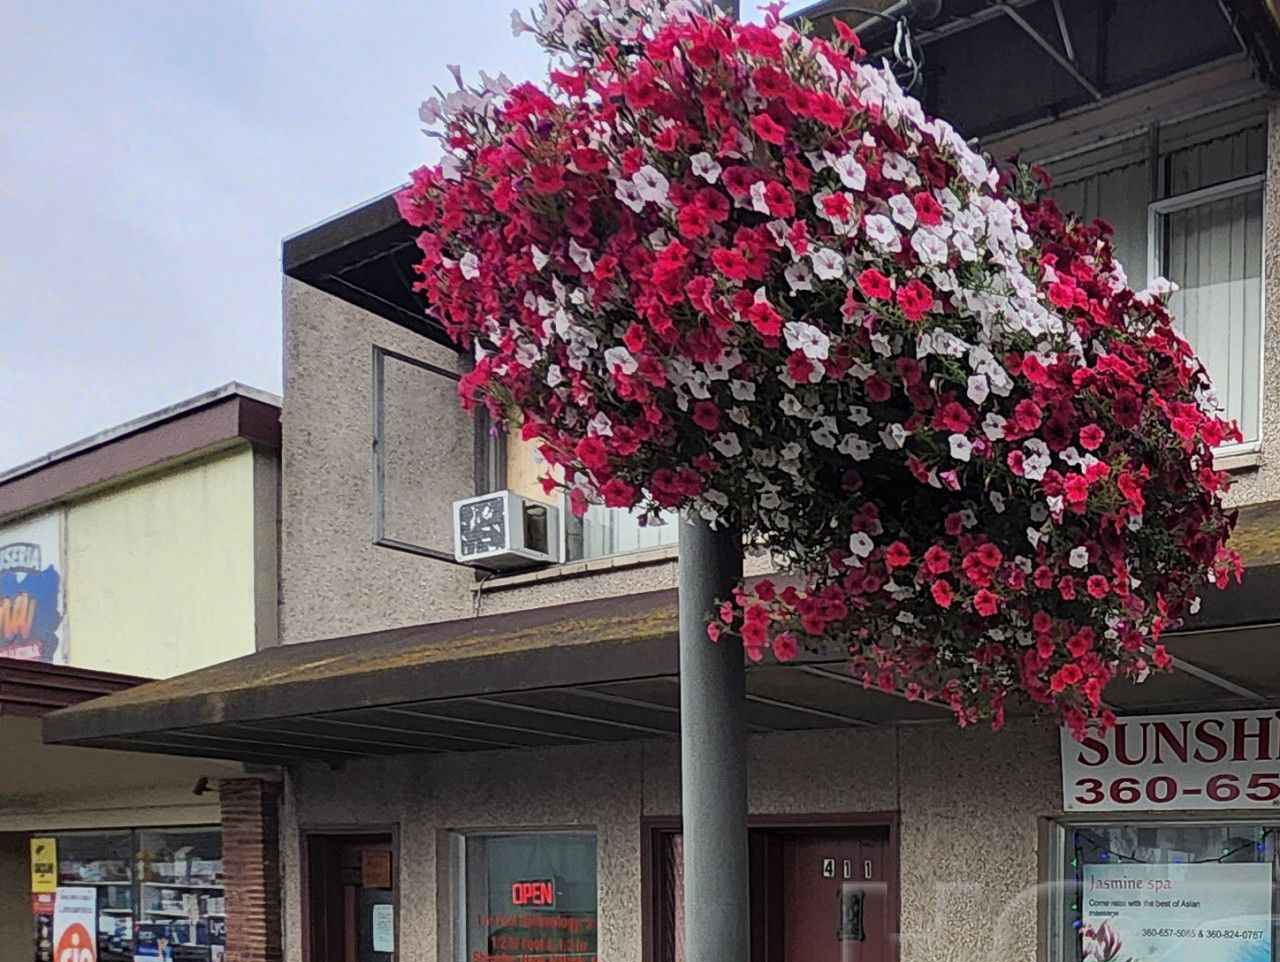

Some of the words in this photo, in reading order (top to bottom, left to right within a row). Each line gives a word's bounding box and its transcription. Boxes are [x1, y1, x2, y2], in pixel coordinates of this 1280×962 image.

[823, 859, 872, 878] 411
[1088, 874, 1143, 893] Jasmine
[1147, 879, 1173, 893] spa
[512, 882, 553, 905] OPEN
[1088, 899, 1109, 907] Come
[1155, 899, 1171, 908] best
[1172, 899, 1180, 908] of
[1180, 900, 1200, 908] Asian
[1198, 929, 1204, 938] &
[1206, 929, 1264, 939] 360-824-0767
